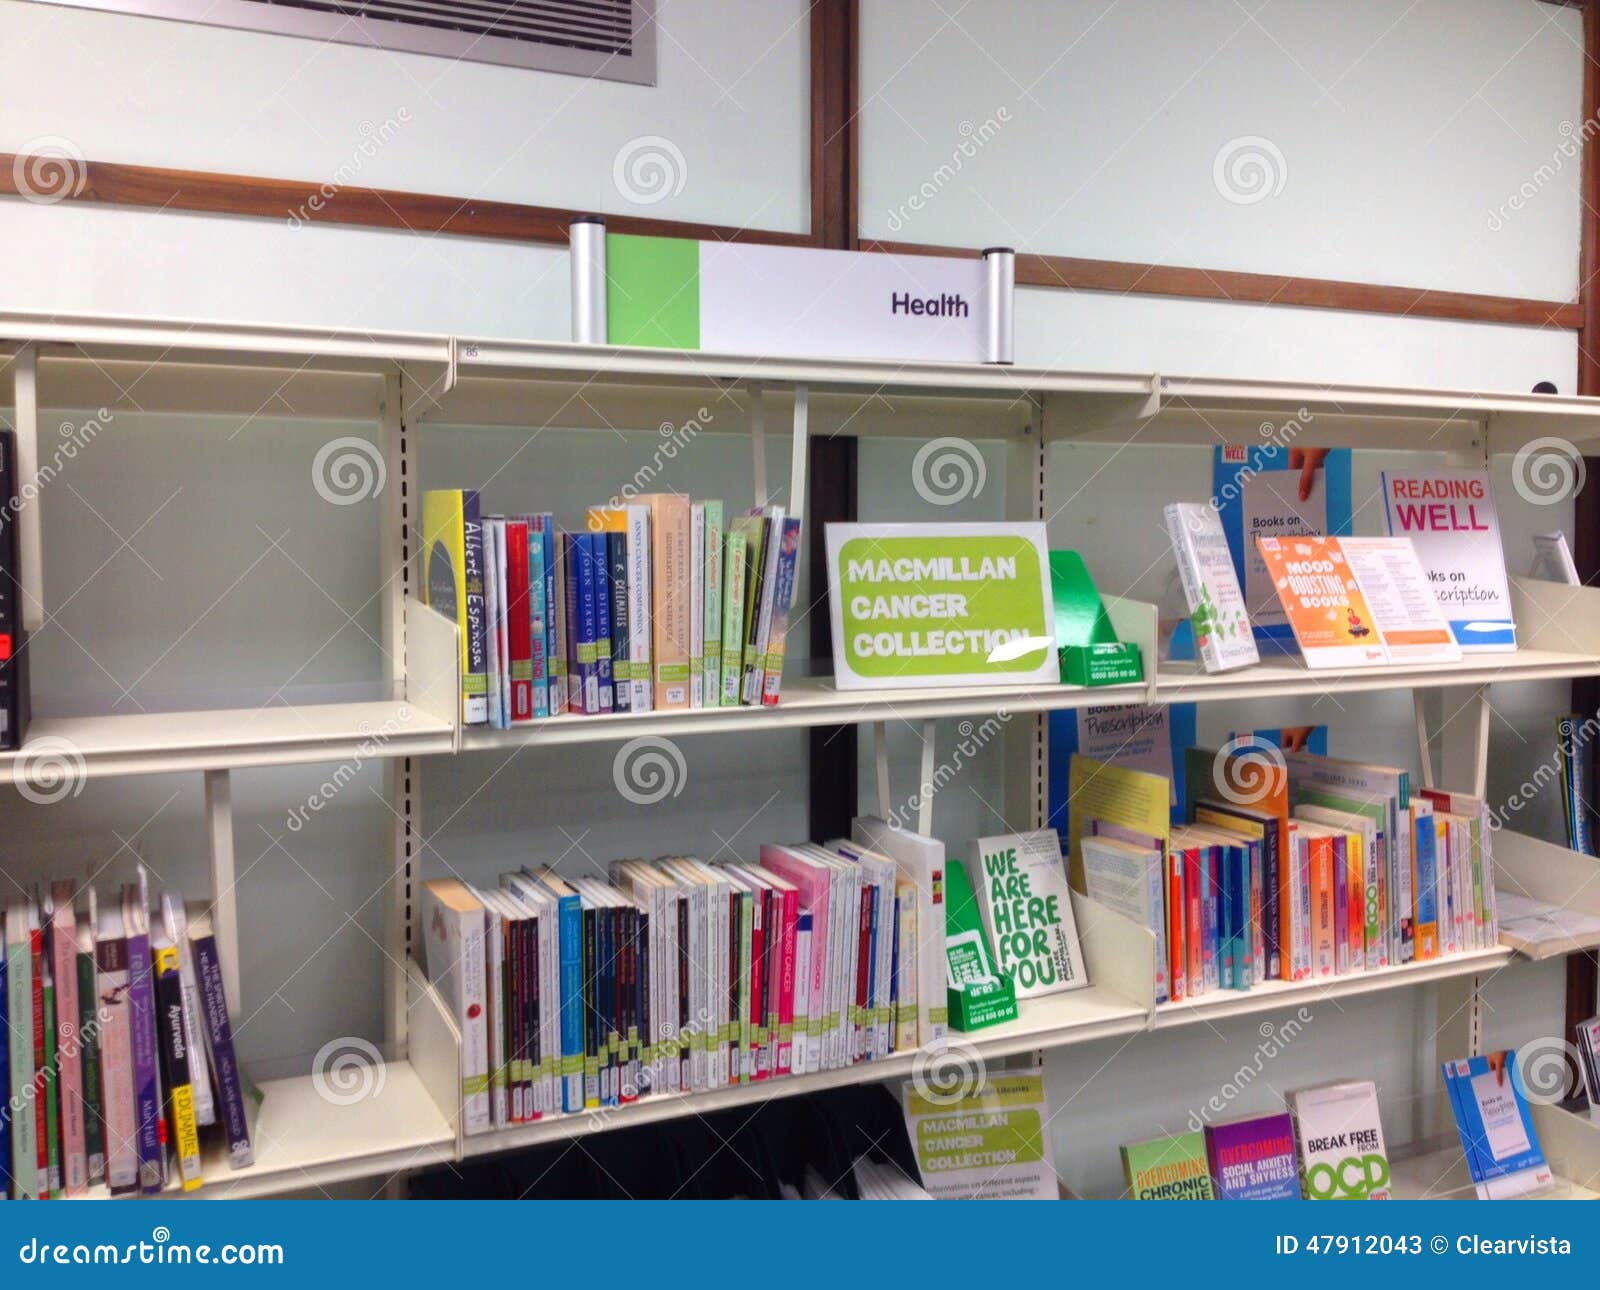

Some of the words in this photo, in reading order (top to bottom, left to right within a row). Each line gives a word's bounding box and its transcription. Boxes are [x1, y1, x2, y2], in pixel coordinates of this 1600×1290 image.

[891, 292, 969, 319] Health
[1393, 479, 1484, 499] READING
[1252, 516, 1285, 528] Books
[1287, 517, 1301, 525] on
[1396, 504, 1489, 531] WELL
[465, 522, 482, 576] Albert
[582, 552, 592, 585] JOHN
[596, 552, 606, 584] JOHN
[848, 556, 1017, 583] MACMILLAN
[1285, 560, 1334, 574] MOOD
[1450, 571, 1465, 582] on
[1287, 575, 1347, 596] BOOSTING
[1435, 585, 1499, 606] cription
[598, 593, 609, 635] DIAMO
[850, 593, 969, 620] CANCER
[1300, 596, 1350, 608] BOOKS
[467, 595, 484, 667] Espinosa
[584, 593, 595, 643] DIAMON
[1085, 707, 1164, 736] Prescription
[985, 848, 1019, 877] WE
[991, 873, 1032, 902] ARE
[993, 895, 1062, 935] HERE
[1366, 886, 1378, 926] OCD
[785, 922, 794, 954] BREAST
[1000, 928, 1051, 963] FOR
[784, 955, 793, 992] CANCER
[1002, 958, 1056, 989] YOU
[170, 1005, 186, 1059] Ayurveda
[923, 1114, 1009, 1133] MACMILLAN
[924, 1135, 984, 1151] CANCER
[1221, 1136, 1292, 1167] OVERCOMING
[1308, 1133, 1347, 1153] BREAK
[1349, 1129, 1378, 1145] FREE
[1357, 1142, 1379, 1152] FROM
[927, 1150, 1016, 1170] COLLECTION
[1137, 1156, 1207, 1188] OVERCOMING
[1223, 1162, 1254, 1179] SOCIAL
[1257, 1153, 1292, 1171] ANXIETY
[1140, 1176, 1209, 1200] CHRONIC
[1225, 1175, 1247, 1191] AND
[1250, 1165, 1295, 1186] SHYNESS
[1308, 1154, 1390, 1200] OCD
